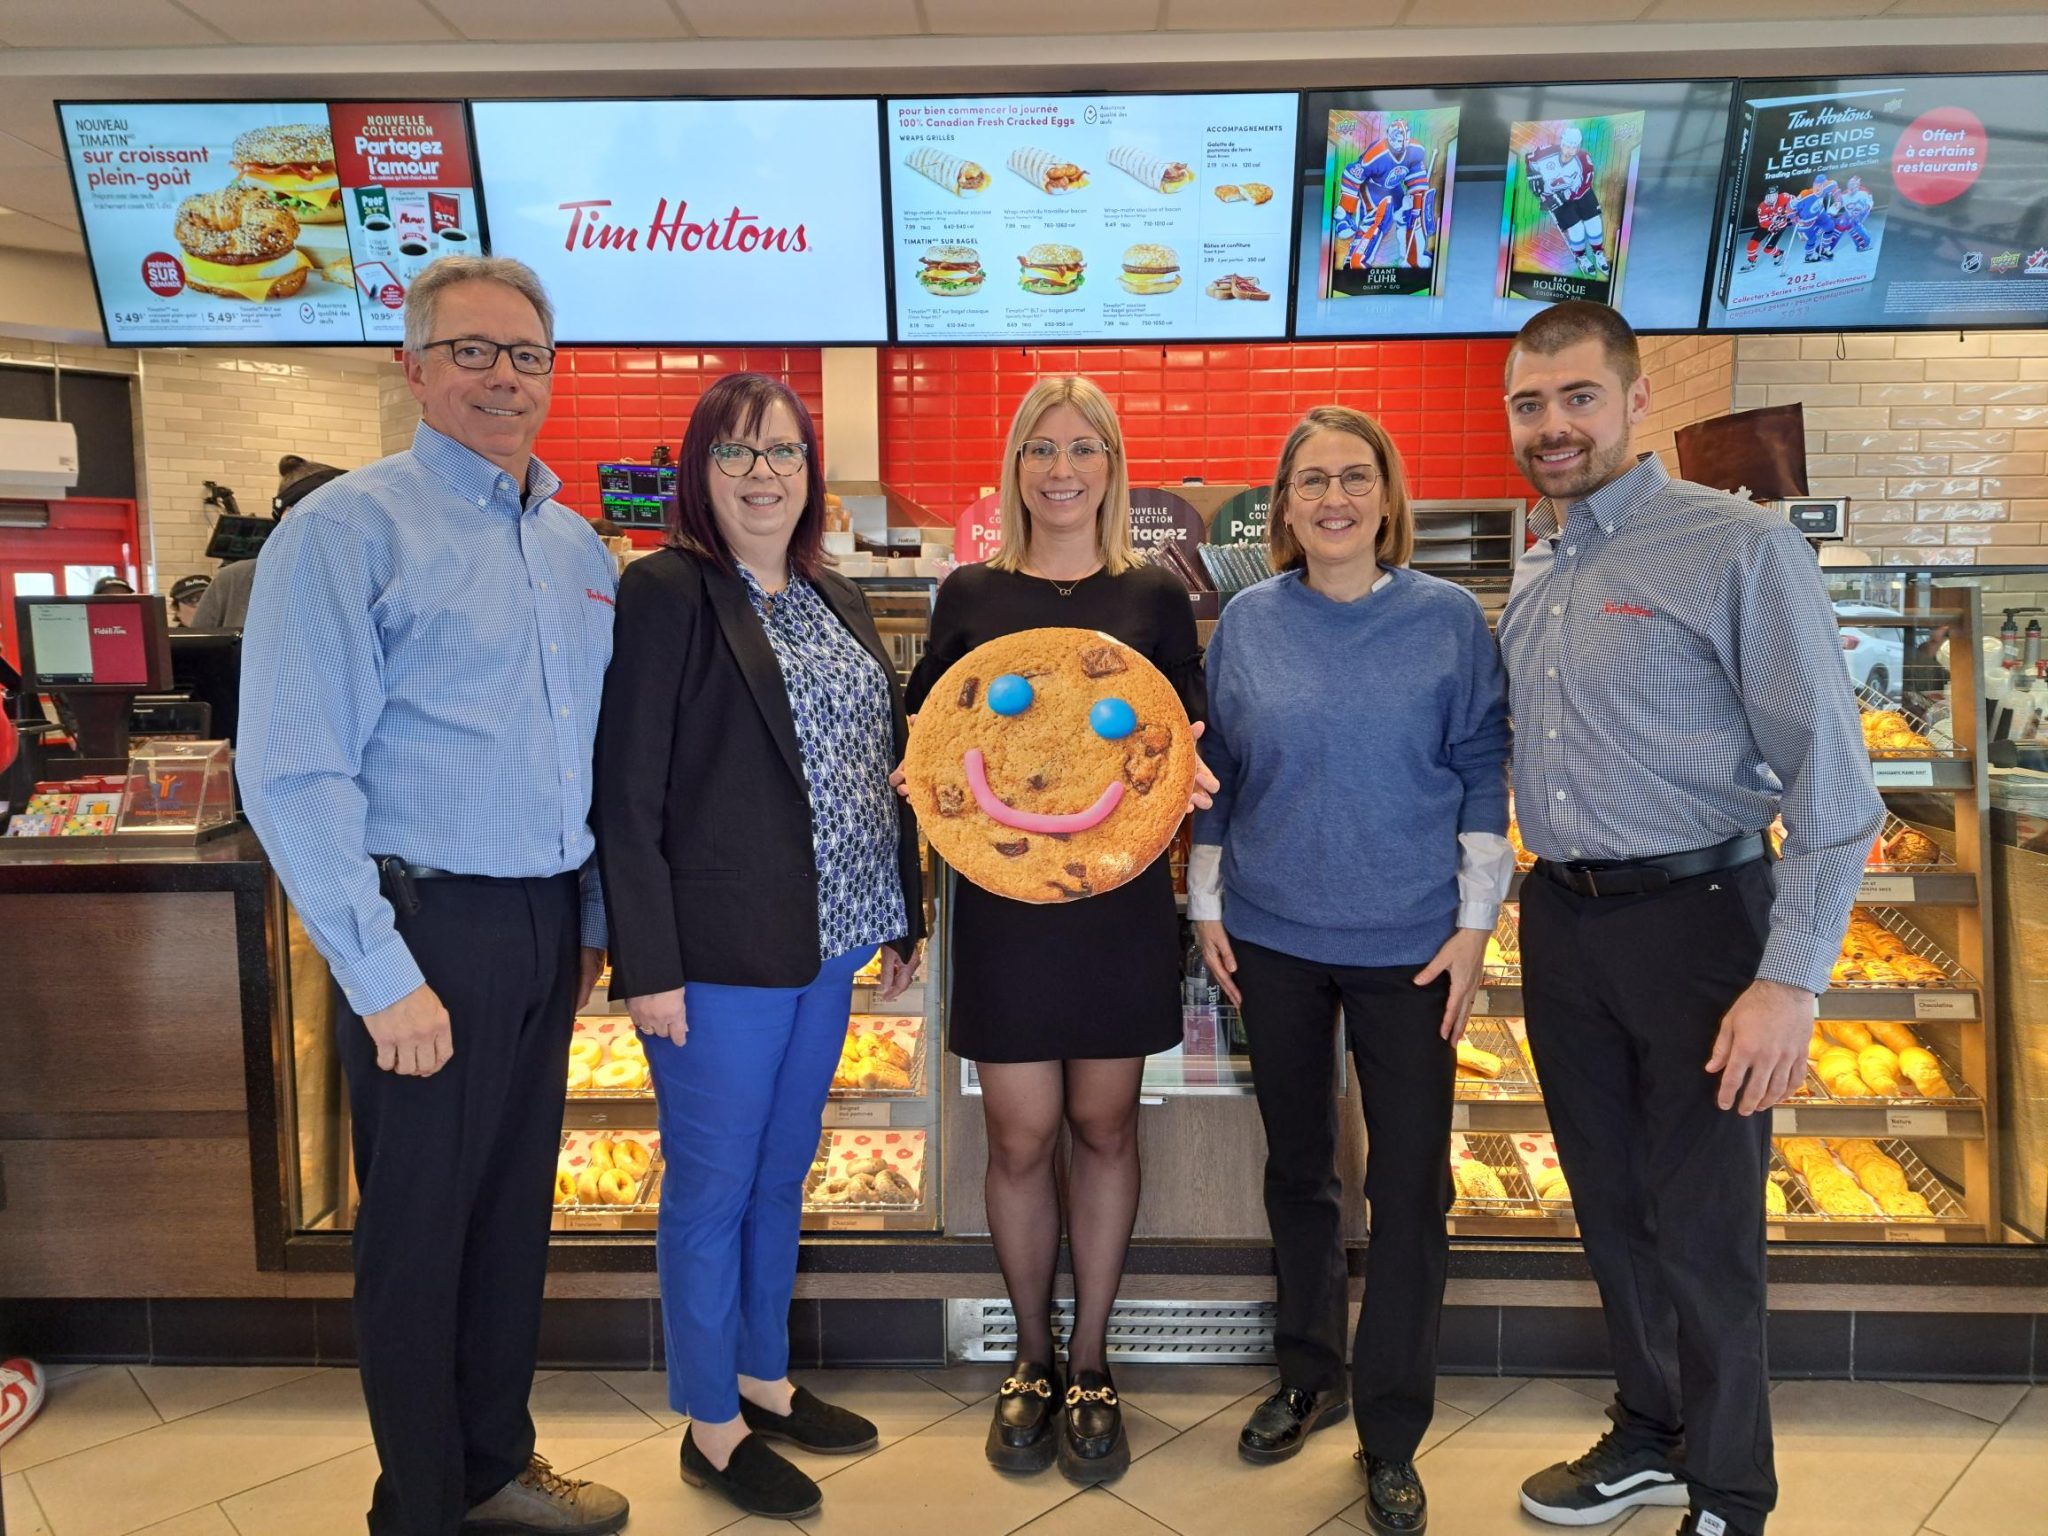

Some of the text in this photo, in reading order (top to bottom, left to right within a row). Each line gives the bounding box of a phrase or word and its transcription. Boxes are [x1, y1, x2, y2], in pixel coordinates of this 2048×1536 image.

[900, 104, 1058, 117] pour bien commencer la journée
[75, 119, 128, 131] NOUVEAU
[367, 115, 425, 126] NOUVELLE
[899, 116, 1075, 128] 100% Canadian Fresh Cracked Eggs
[1788, 107, 1873, 130] Tim Hortons
[362, 126, 433, 136] COLLECTION
[1922, 128, 1966, 142] Offert
[1779, 127, 1876, 151] LEGENDS
[355, 136, 443, 160] Partagez
[1906, 145, 1976, 158] à certains
[84, 147, 209, 163] sur croissant
[1767, 143, 1880, 170] LÉGENDES
[368, 156, 439, 175] l'amour
[1897, 161, 1978, 174] restaurants
[88, 168, 191, 190] plein-goût
[1764, 171, 1791, 180] Trading
[1792, 168, 1812, 176] Cards
[559, 197, 806, 252] Tim Hortons
[149, 268, 179, 281] SUR
[1368, 275, 1397, 283] FUHR
[1787, 273, 1816, 285] 2023
[1533, 280, 1586, 295] BOURQUE
[1130, 507, 1168, 515] OUVELLE
[1131, 526, 1187, 546] tagez
